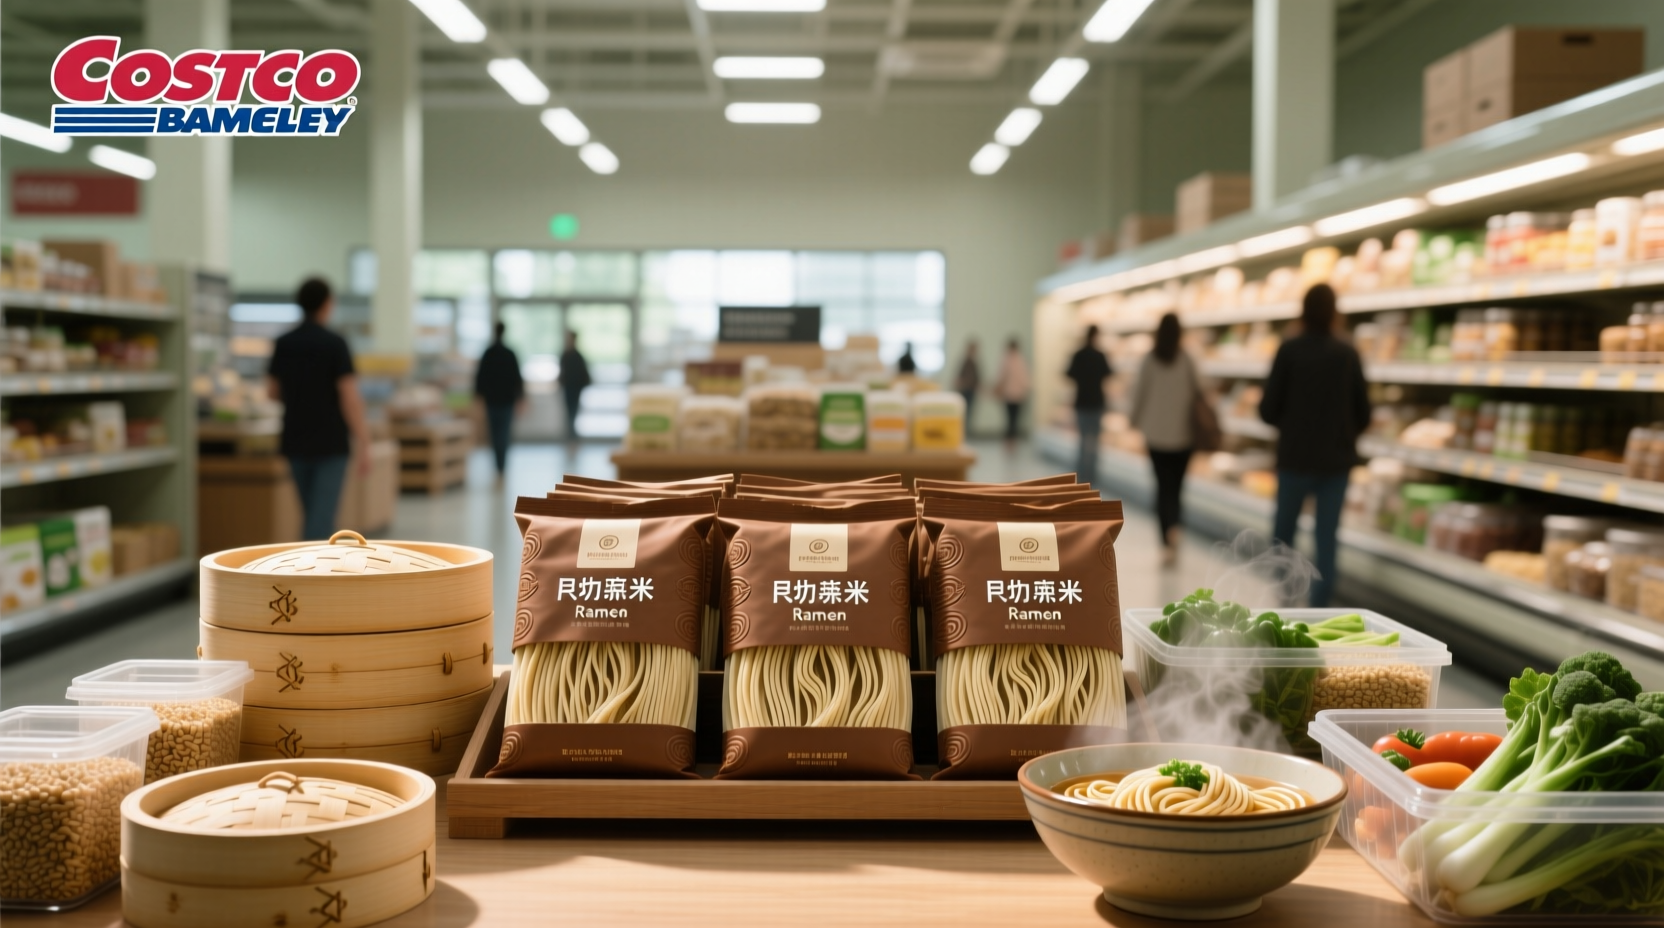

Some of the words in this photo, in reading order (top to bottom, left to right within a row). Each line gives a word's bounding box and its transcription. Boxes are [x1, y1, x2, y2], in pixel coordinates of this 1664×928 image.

[575, 604, 628, 619] Ramen
[793, 607, 847, 622] Ramen
[1008, 606, 1062, 621] Ramen
